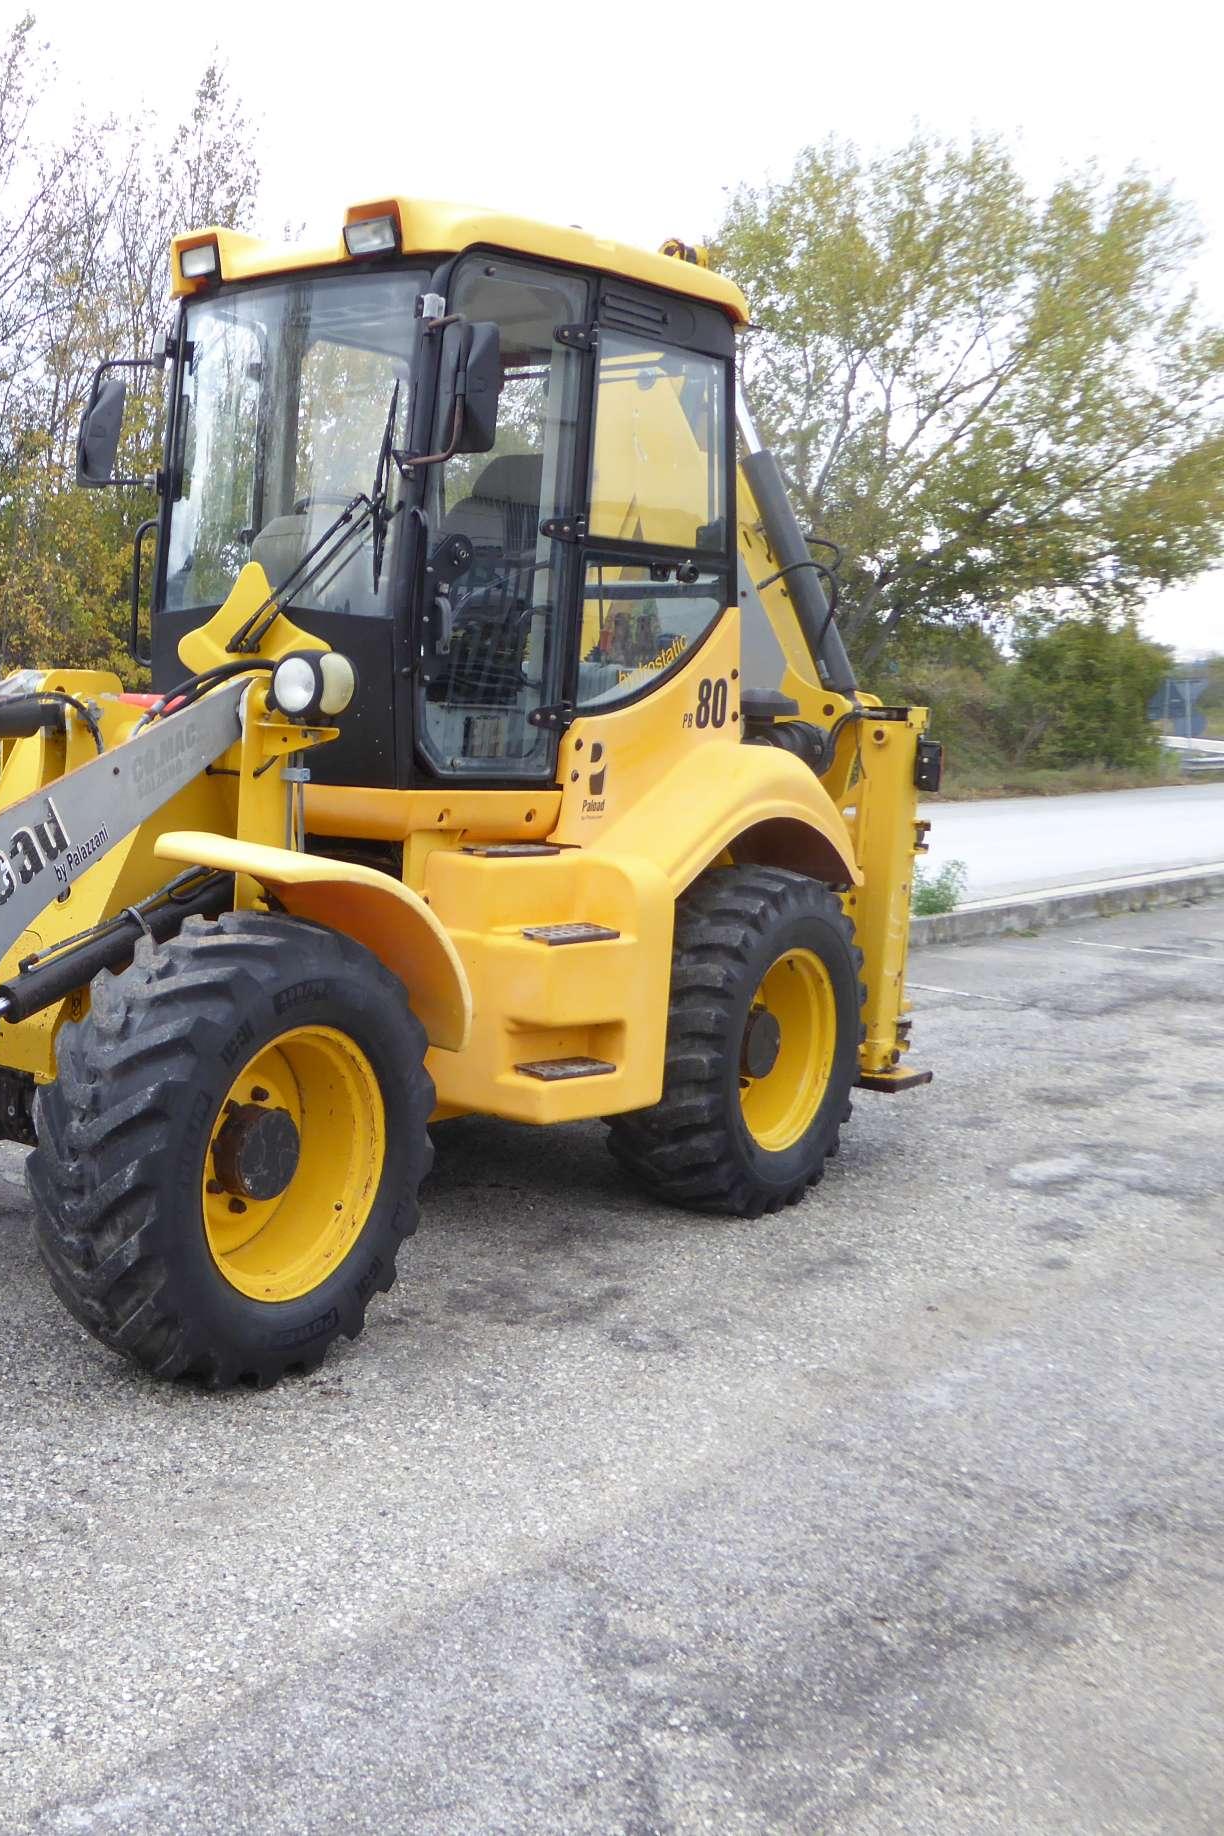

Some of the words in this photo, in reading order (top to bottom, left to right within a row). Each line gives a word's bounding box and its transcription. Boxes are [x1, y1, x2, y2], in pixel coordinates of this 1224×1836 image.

[682, 712, 694, 729] PB
[695, 678, 728, 730] 80
[53, 863, 68, 882] by
[66, 822, 109, 871] Palazzani
